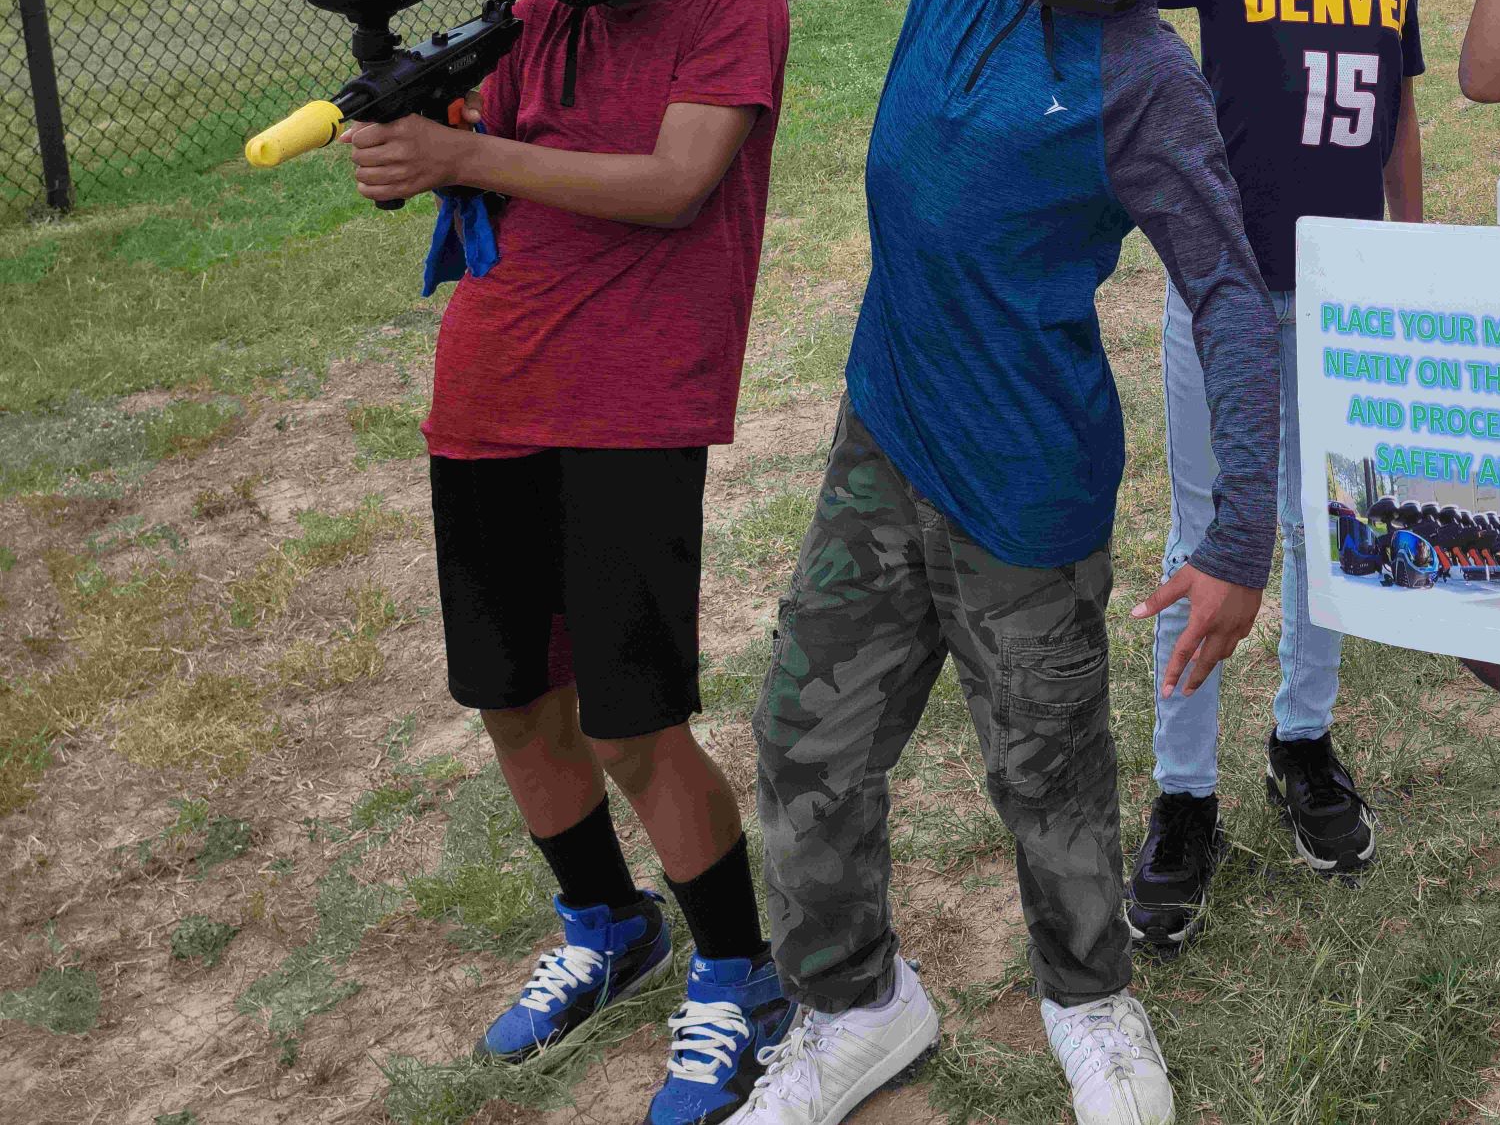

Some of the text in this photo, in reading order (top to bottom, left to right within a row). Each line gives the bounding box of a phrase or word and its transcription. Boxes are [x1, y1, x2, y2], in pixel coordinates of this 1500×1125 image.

[1302, 51, 1379, 147] 15
[1322, 304, 1395, 335] PLACE
[1400, 311, 1476, 345] YOUR
[1324, 349, 1410, 385] NEATLY
[1418, 359, 1460, 389] ON
[1349, 398, 1404, 429] AND
[1376, 446, 1471, 481] SAFETY
